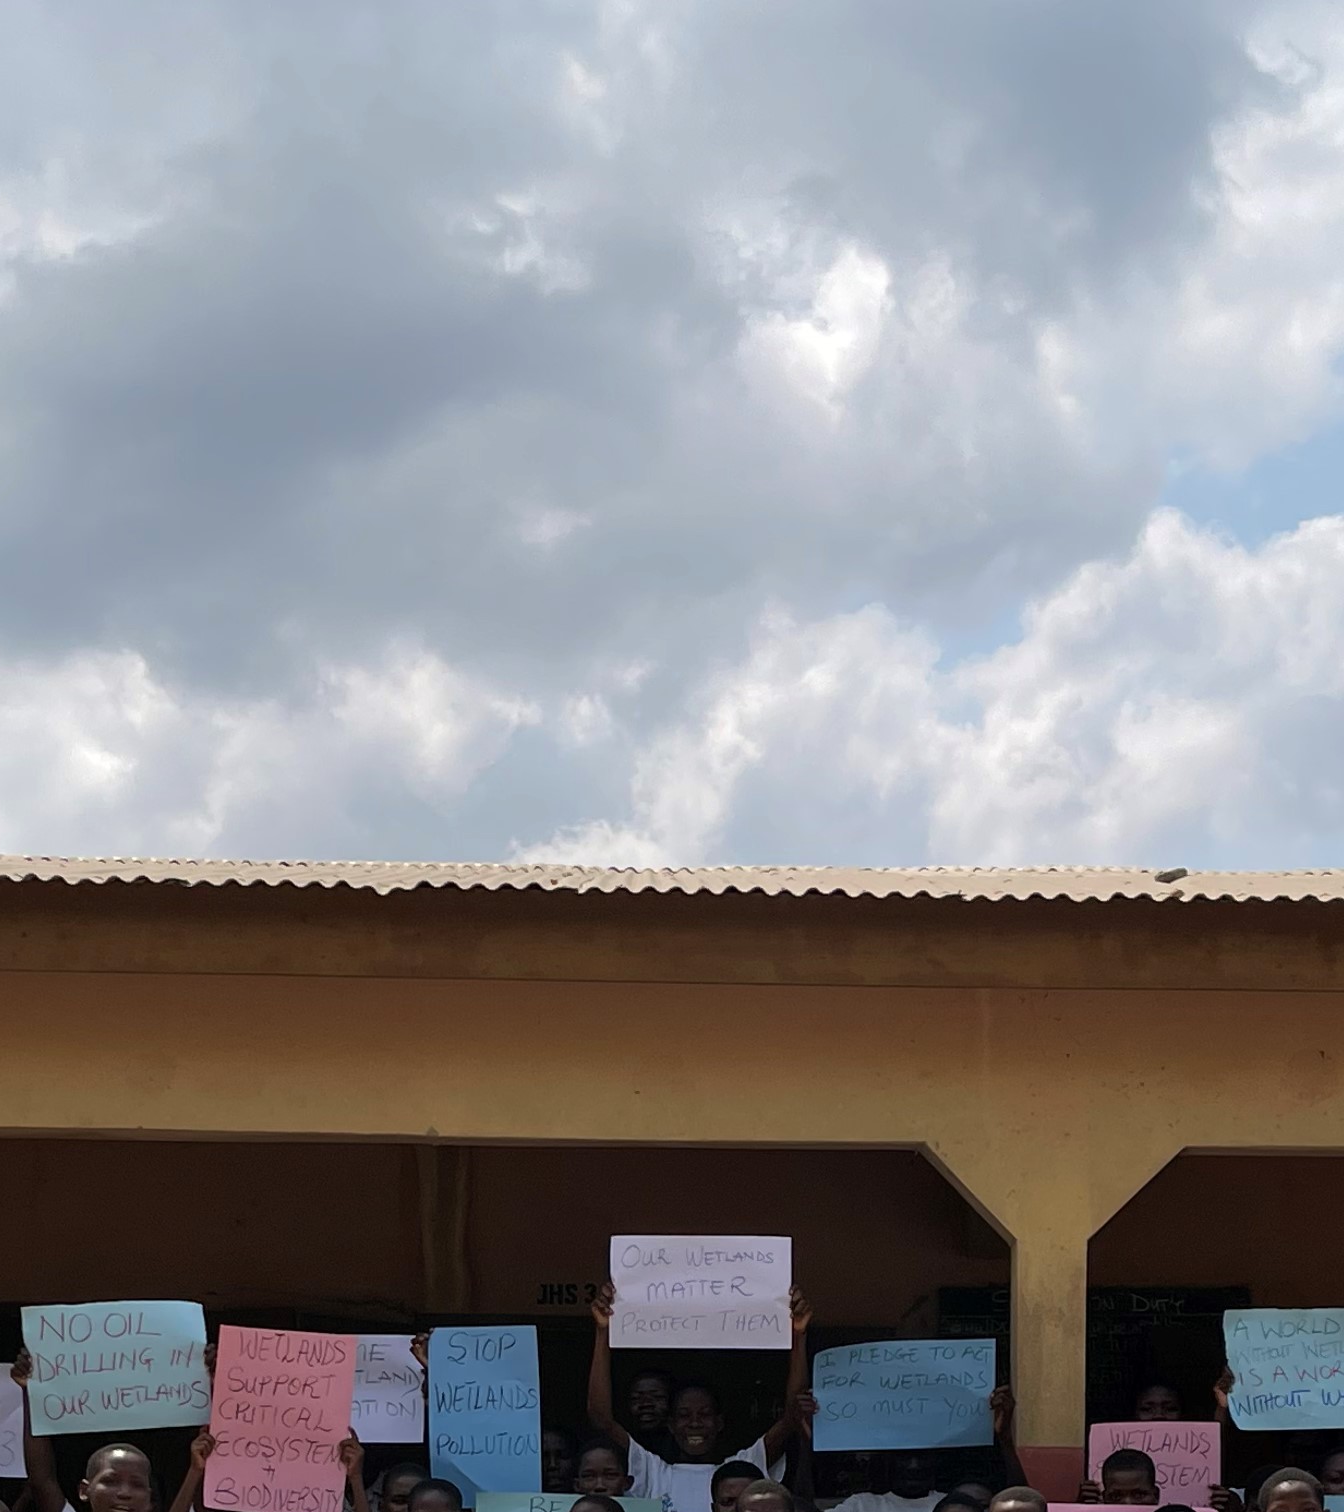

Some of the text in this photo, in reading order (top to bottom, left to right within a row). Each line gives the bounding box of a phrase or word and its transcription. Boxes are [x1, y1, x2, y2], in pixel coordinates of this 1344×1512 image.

[686, 1246, 774, 1266] WETLANDS
[537, 1283, 578, 1305] JHS
[647, 1276, 753, 1302] MATTER
[40, 1312, 161, 1343] NO OIL
[621, 1310, 782, 1335] PROTECT THEM
[1233, 1317, 1341, 1341] A WORLD
[239, 1332, 347, 1368] WETLANDS
[447, 1332, 517, 1365] STOP
[820, 1346, 994, 1369] I PLEDGE TO ACT
[1232, 1342, 1295, 1365] WITHOUT
[35, 1342, 195, 1383] DRILLING IN
[227, 1367, 336, 1400] SUPPORT
[822, 1371, 989, 1390] FOR WETLANDS
[1238, 1366, 1263, 1387] IS
[1272, 1365, 1288, 1384] A
[43, 1380, 210, 1421] OUR WETLANDS
[435, 1381, 538, 1414] WETLANDS
[1231, 1389, 1312, 1417] WITHOUT
[826, 1398, 985, 1425] SO MUST YOU
[437, 1432, 539, 1456] POLLUTION
[1109, 1428, 1212, 1460] WETLANDS
